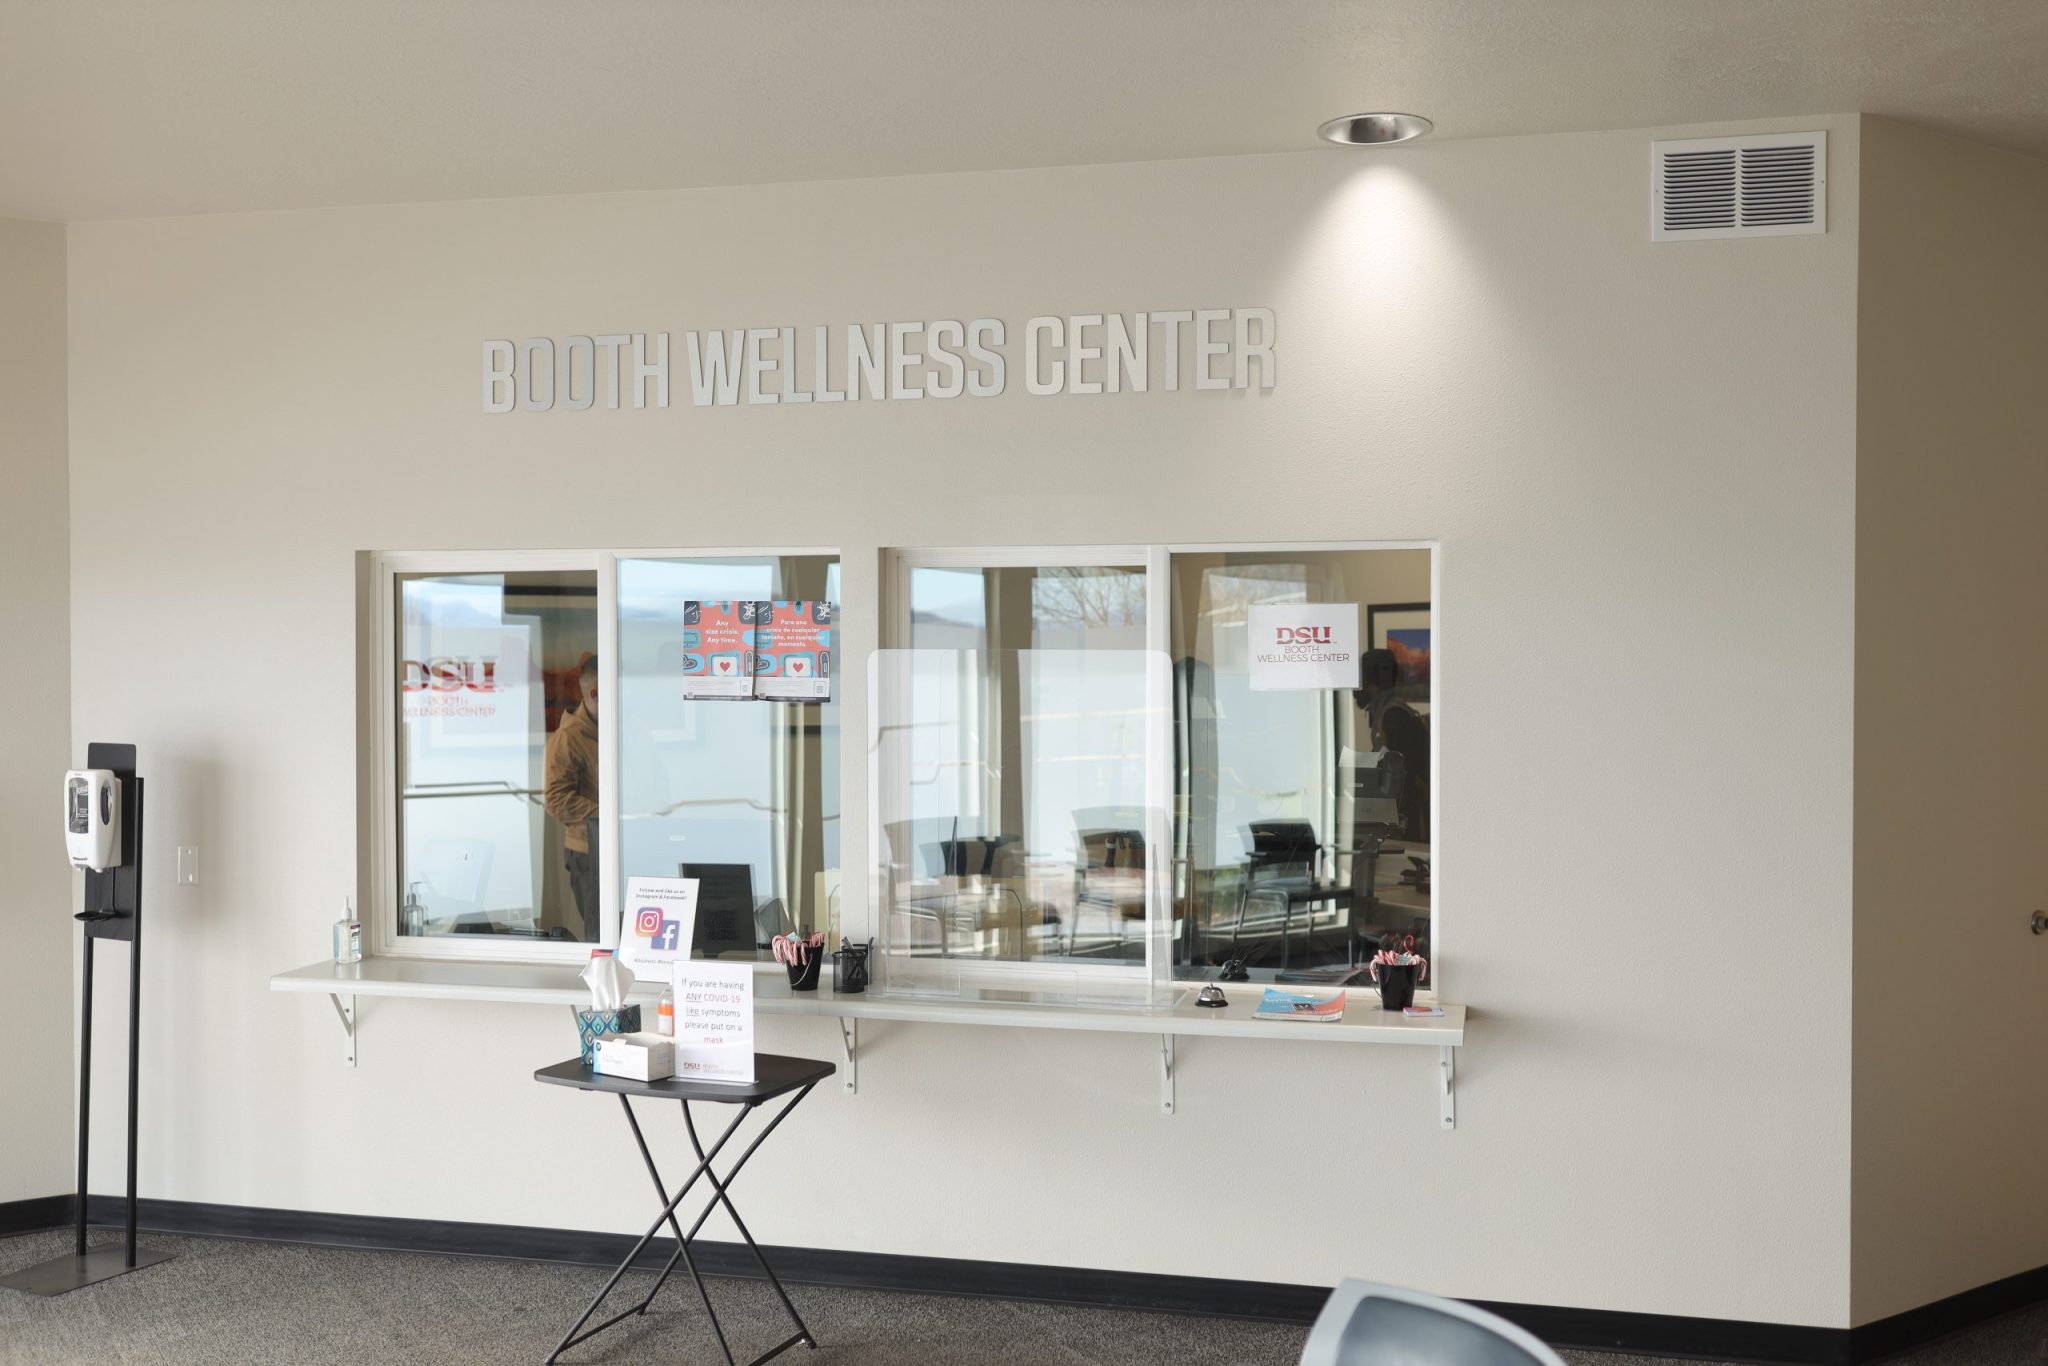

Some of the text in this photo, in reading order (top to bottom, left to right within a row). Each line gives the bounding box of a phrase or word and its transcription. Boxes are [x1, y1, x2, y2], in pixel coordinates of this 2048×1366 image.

[482, 307, 1277, 413] BOOTH WELLNESS CENTER
[707, 637, 720, 645] Any
[1275, 626, 1332, 645] DSU
[1284, 645, 1320, 654] BOOTH
[1257, 652, 1350, 663] WELLNESS CENTER
[681, 978, 687, 987] If
[689, 980, 703, 988] you
[719, 980, 745, 991] having
[685, 992, 741, 1004] ANY COVID-19
[686, 1007, 741, 1018] like symptoms
[684, 1021, 709, 1030] please
[710, 1023, 724, 1031] put
[703, 1036, 724, 1044] mask
[683, 1062, 701, 1070] DSU
